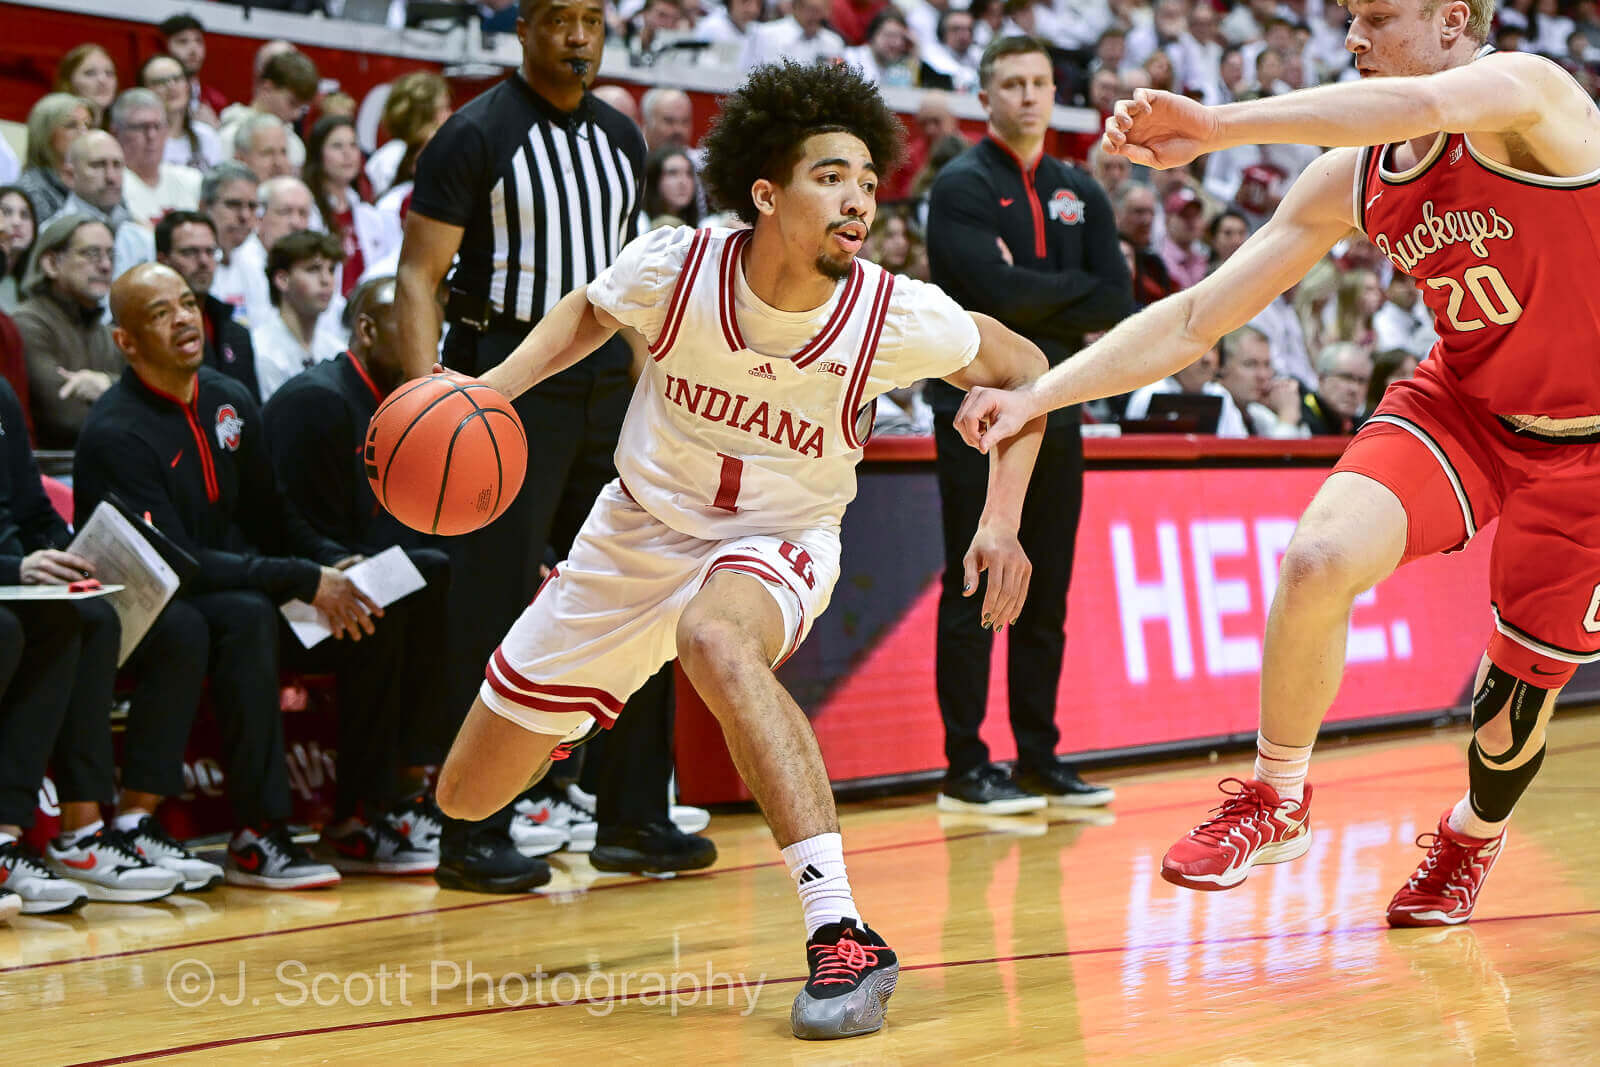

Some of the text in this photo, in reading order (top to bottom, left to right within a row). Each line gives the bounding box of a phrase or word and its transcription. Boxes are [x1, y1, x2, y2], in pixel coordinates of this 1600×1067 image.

[1375, 200, 1514, 274] Buckeyes
[1426, 264, 1524, 332] 20
[748, 369, 777, 381] adidas
[664, 374, 825, 459] INDIANA
[705, 452, 744, 513] 1
